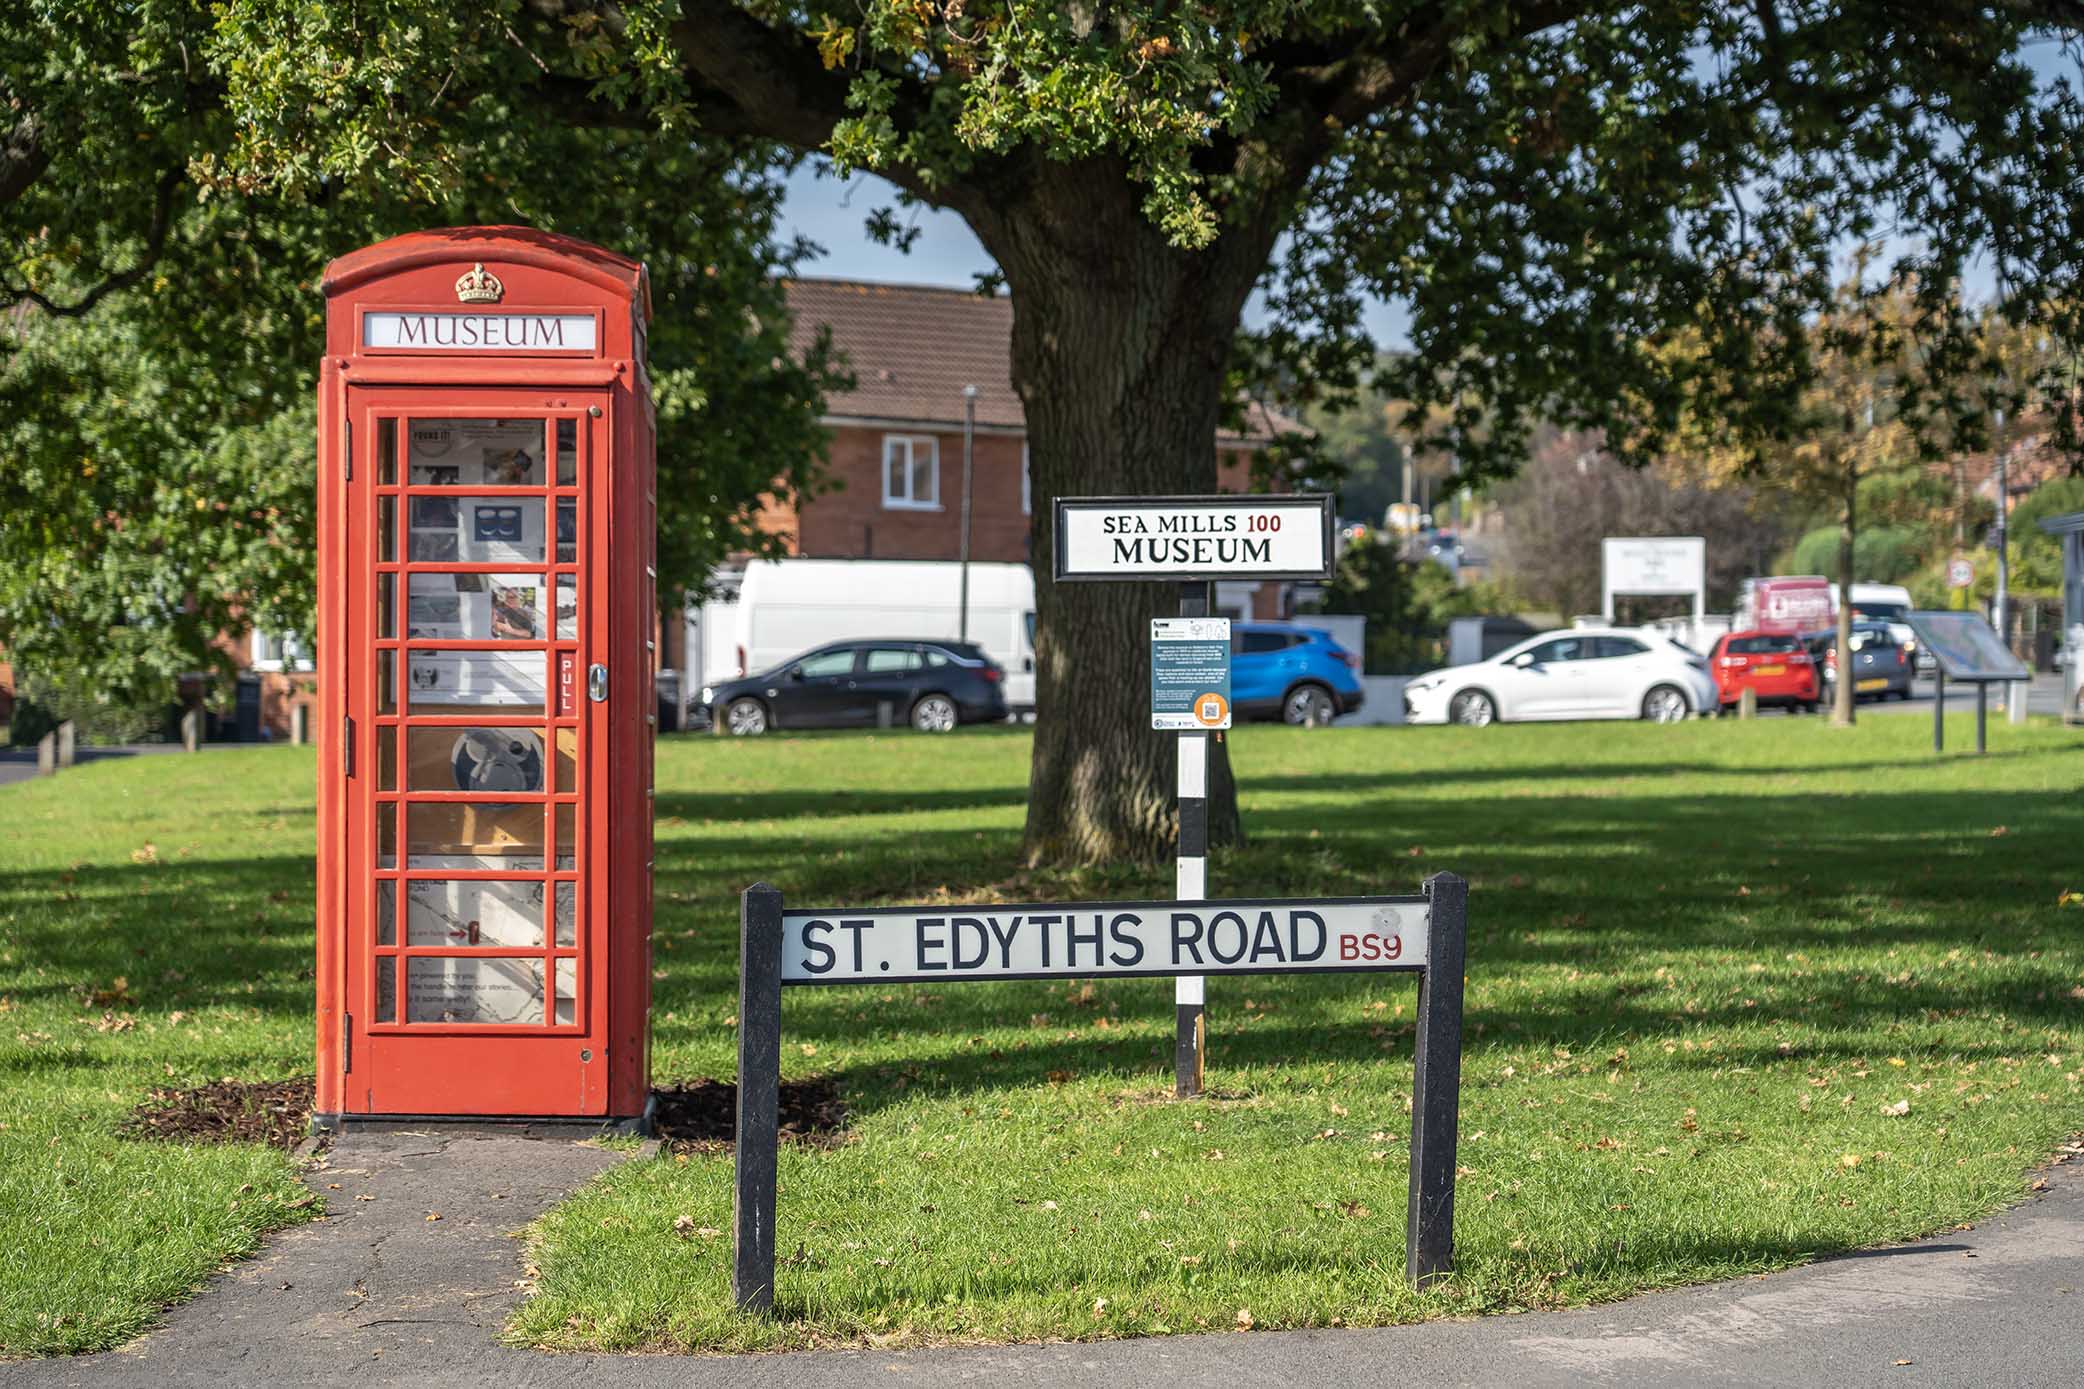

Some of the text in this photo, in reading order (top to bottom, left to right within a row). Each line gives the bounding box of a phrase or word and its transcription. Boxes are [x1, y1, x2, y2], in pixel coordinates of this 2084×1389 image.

[397, 315, 564, 346] MUSEUM
[1103, 515, 1281, 534] SEA MILLS 100
[1113, 537, 1272, 564] MUSEUM
[562, 660, 571, 709] PULL
[800, 910, 1402, 975] ST. EDYTHS ROAD BS9
